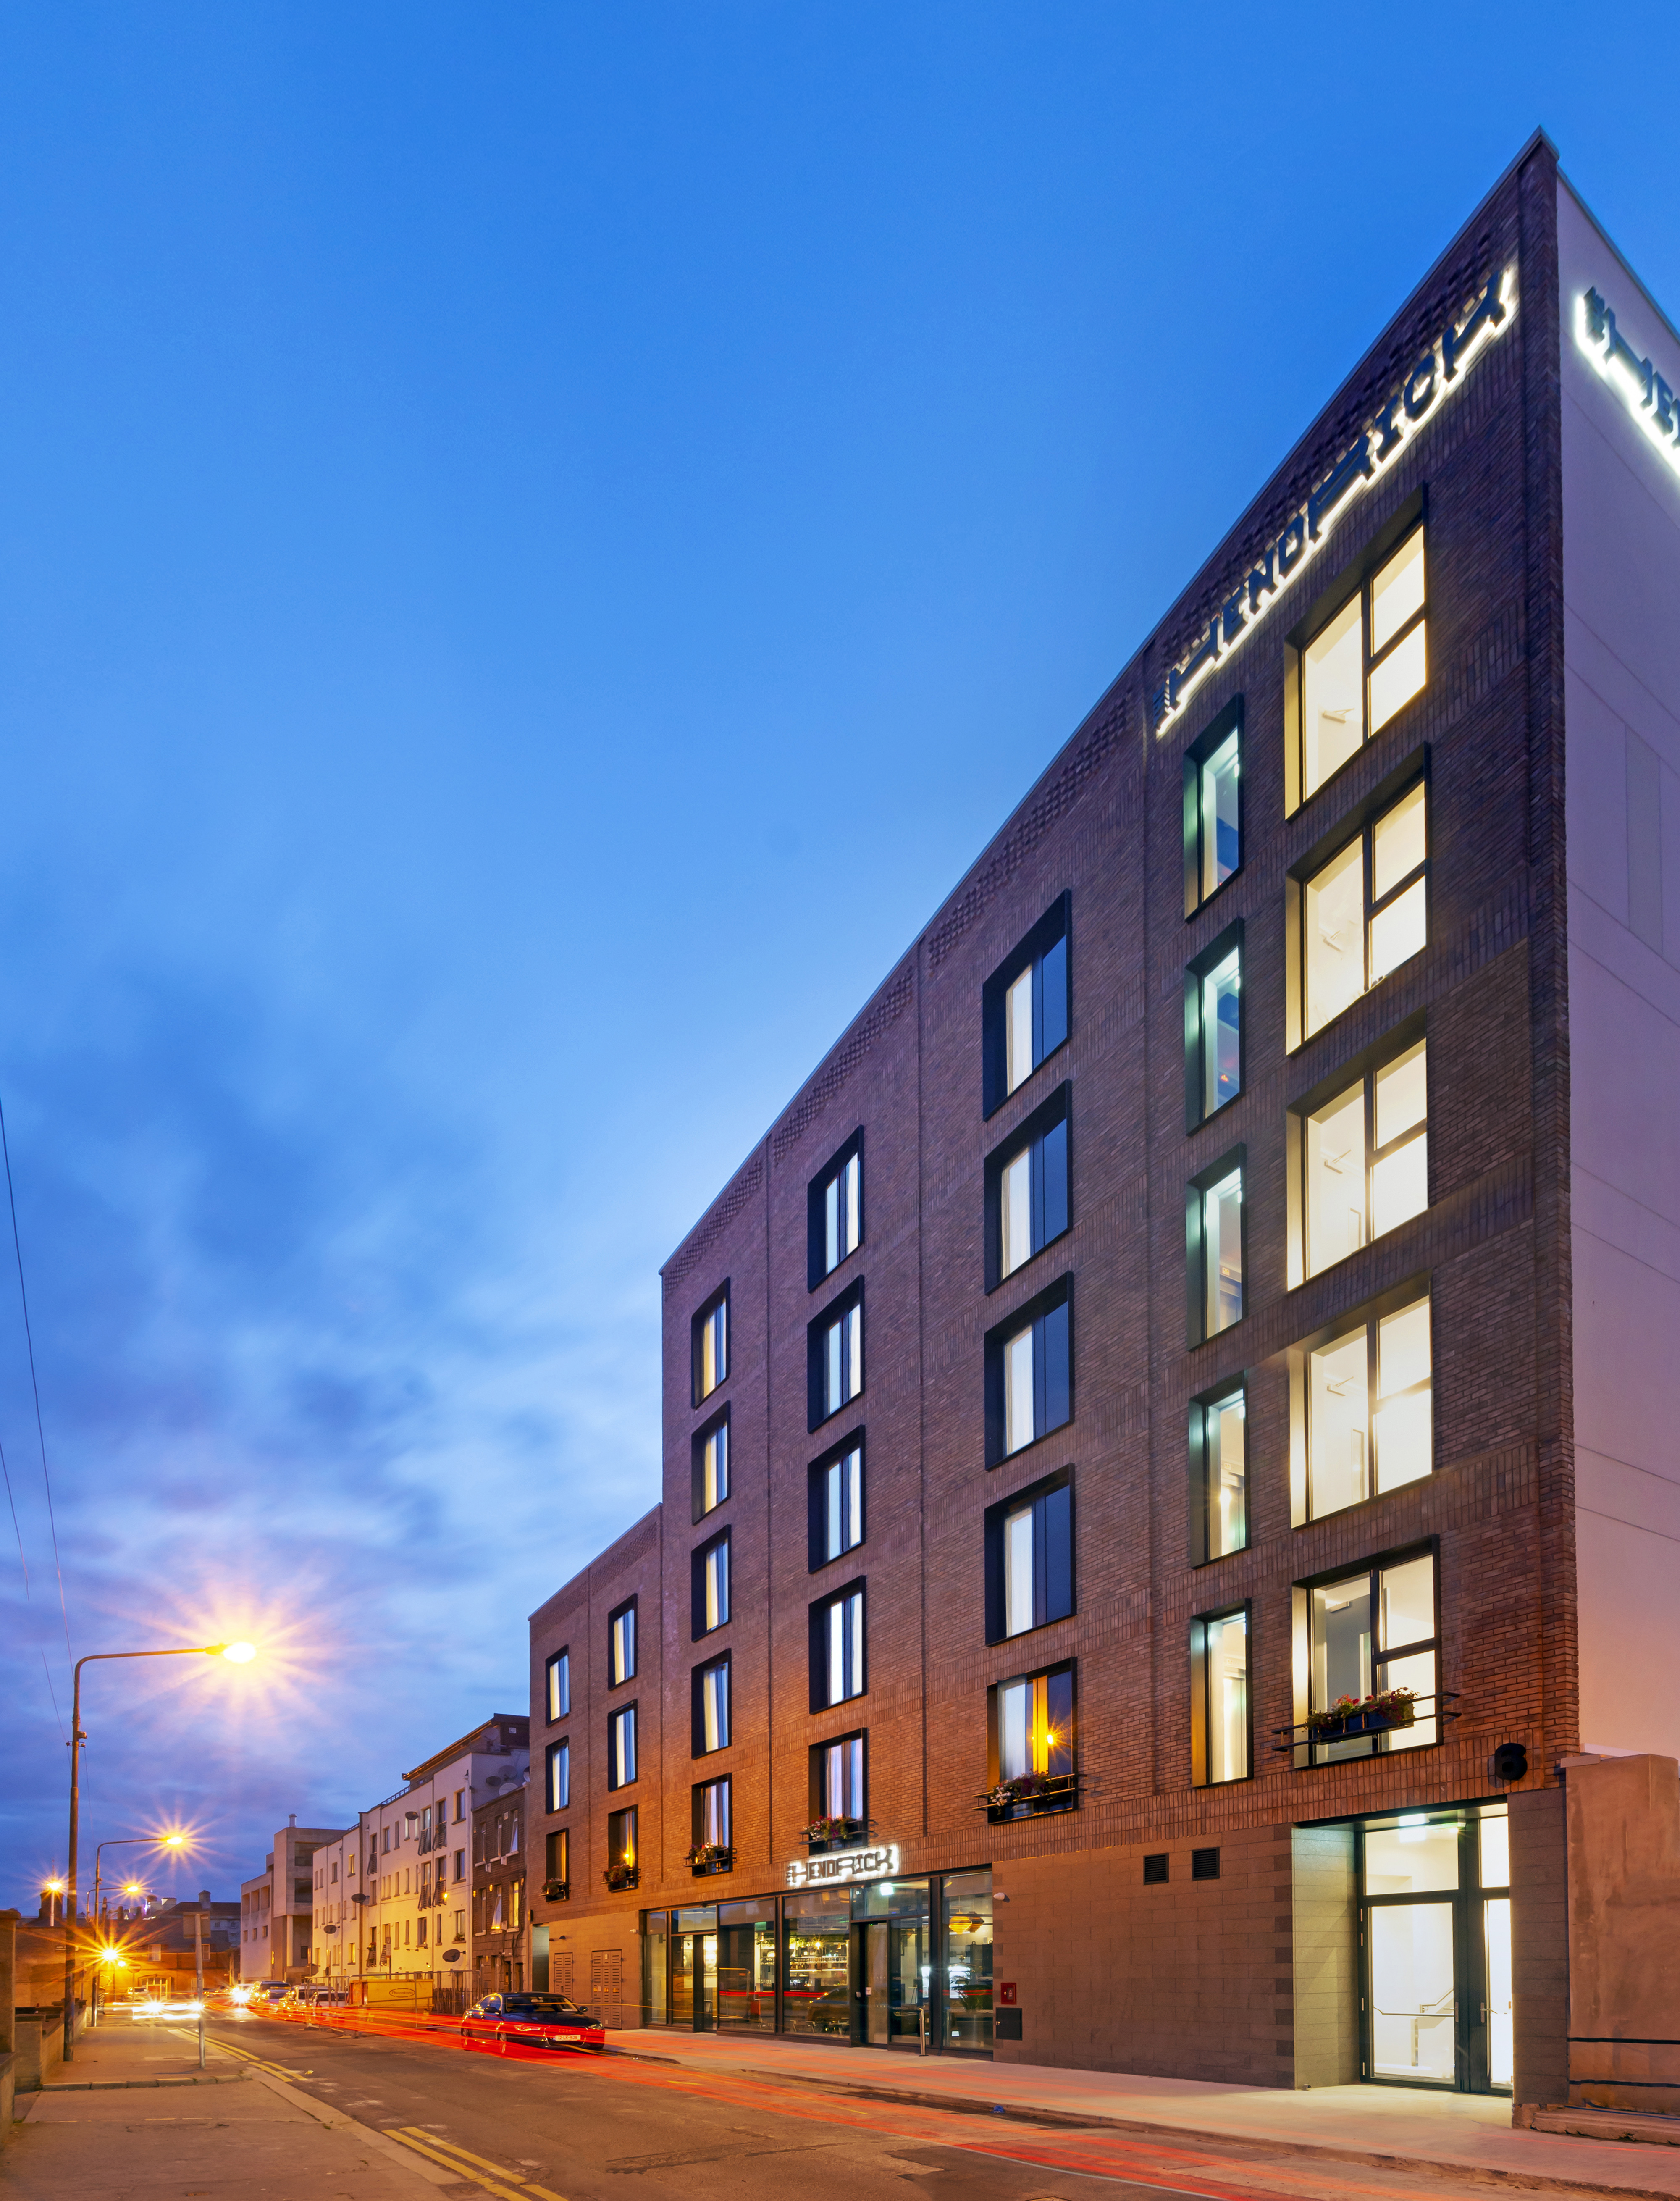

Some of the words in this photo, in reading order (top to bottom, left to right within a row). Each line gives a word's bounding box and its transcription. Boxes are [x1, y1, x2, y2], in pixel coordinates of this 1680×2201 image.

[1169, 271, 1506, 711] HENDRICK
[1494, 1743, 1528, 1780] 6
[792, 1849, 894, 1883] HENDRICK
